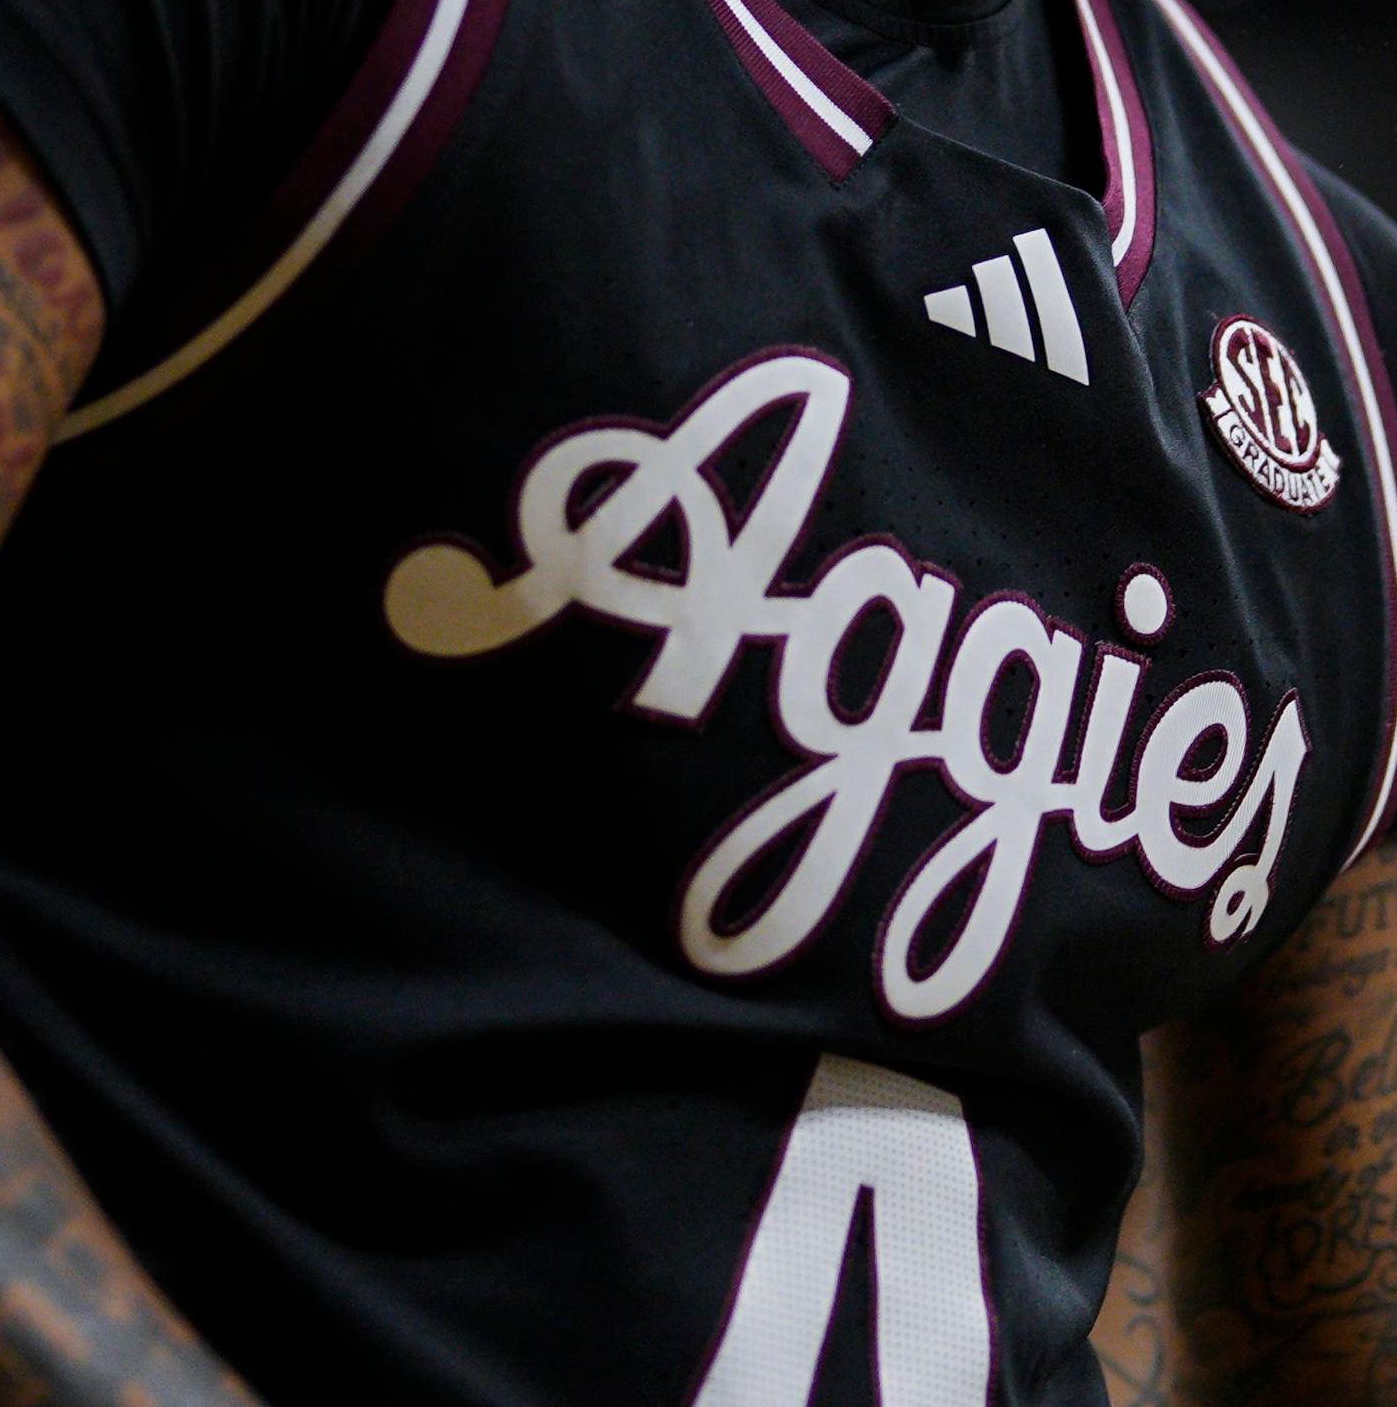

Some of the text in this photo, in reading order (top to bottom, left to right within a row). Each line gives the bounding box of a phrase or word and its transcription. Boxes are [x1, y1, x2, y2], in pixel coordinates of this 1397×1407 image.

[1226, 327, 1311, 455] SEC
[1229, 424, 1332, 505] GRADUATE
[383, 350, 1313, 1024] Aggies
